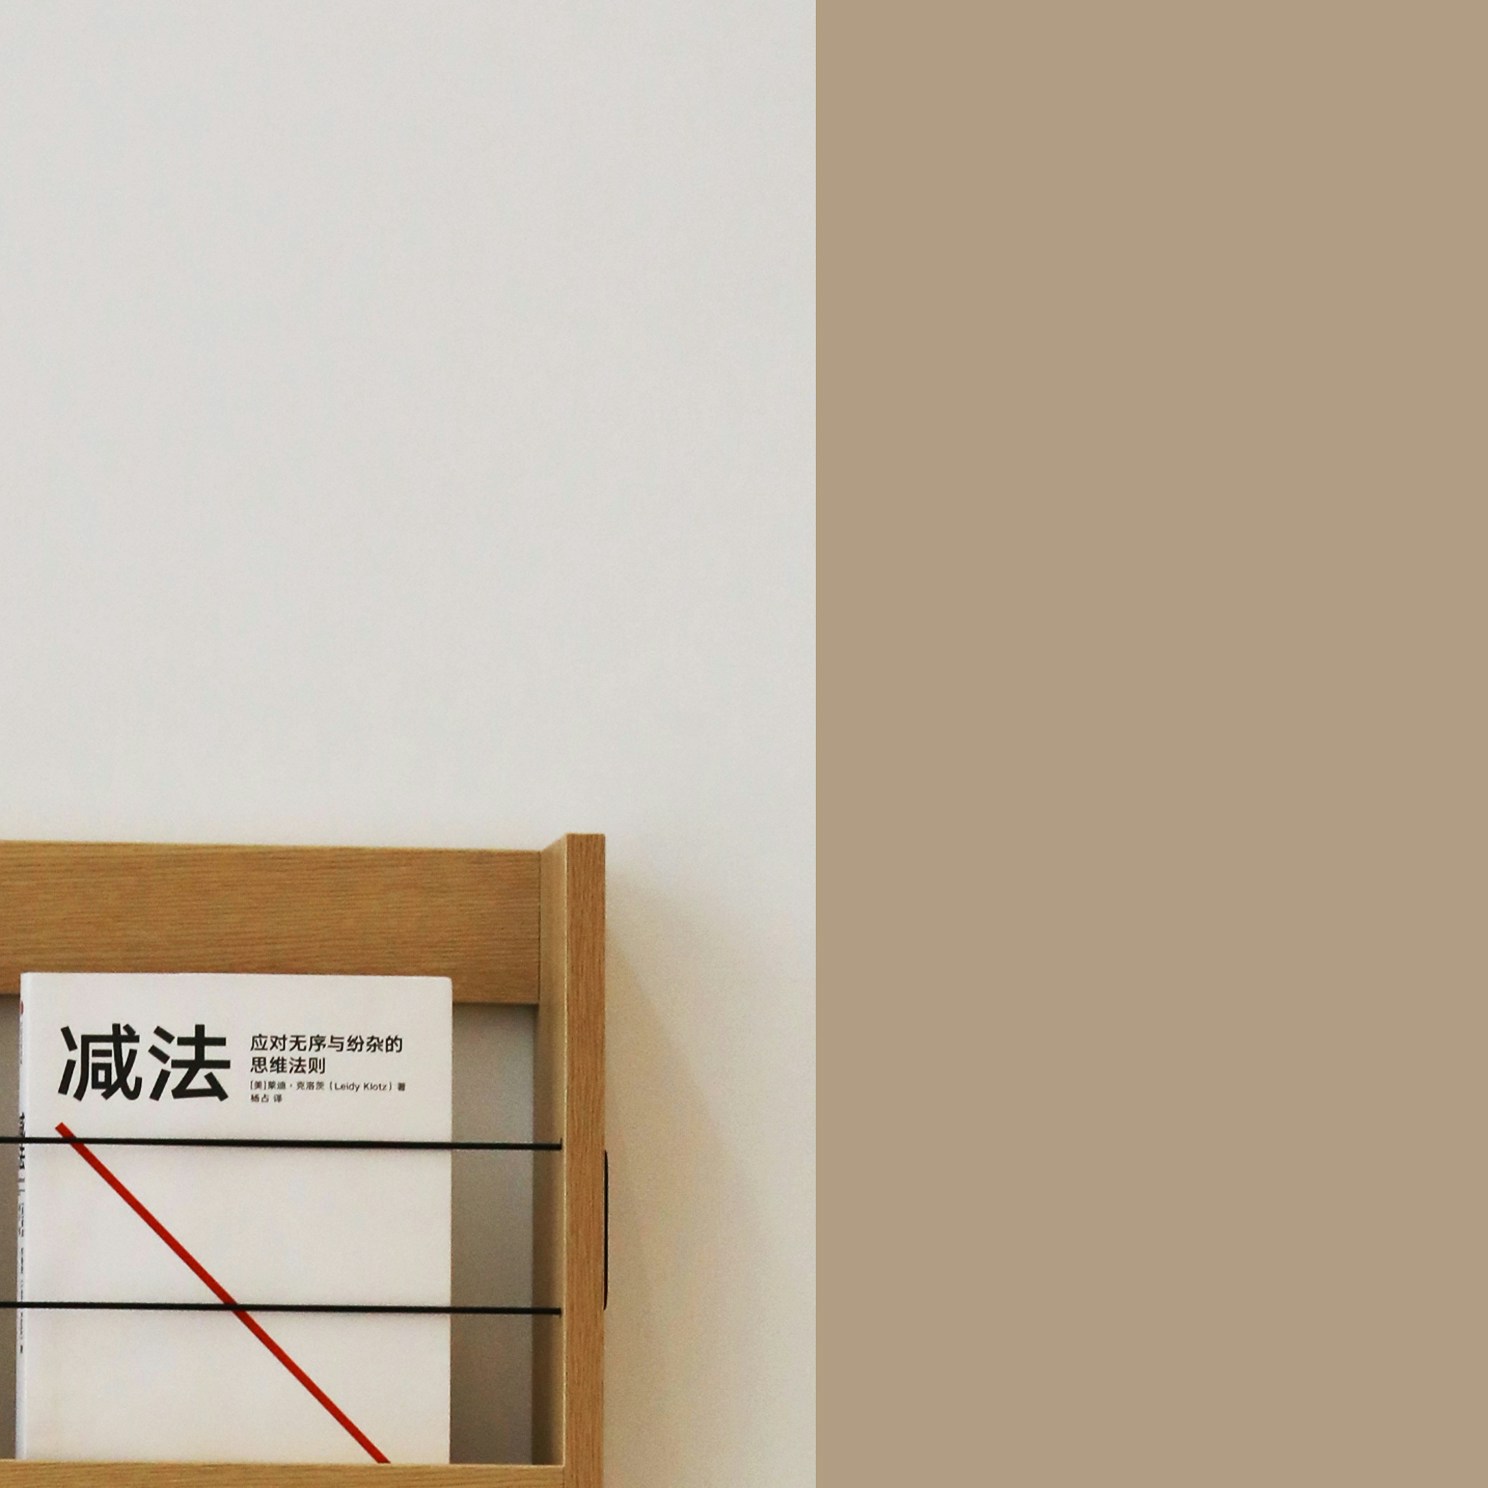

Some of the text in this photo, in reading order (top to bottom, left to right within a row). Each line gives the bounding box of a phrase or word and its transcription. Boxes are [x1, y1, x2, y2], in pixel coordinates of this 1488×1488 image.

[250, 1033, 404, 1053] 应对无序与纷杂的
[57, 1022, 231, 1102] 减法
[250, 1056, 327, 1075] 思维法则
